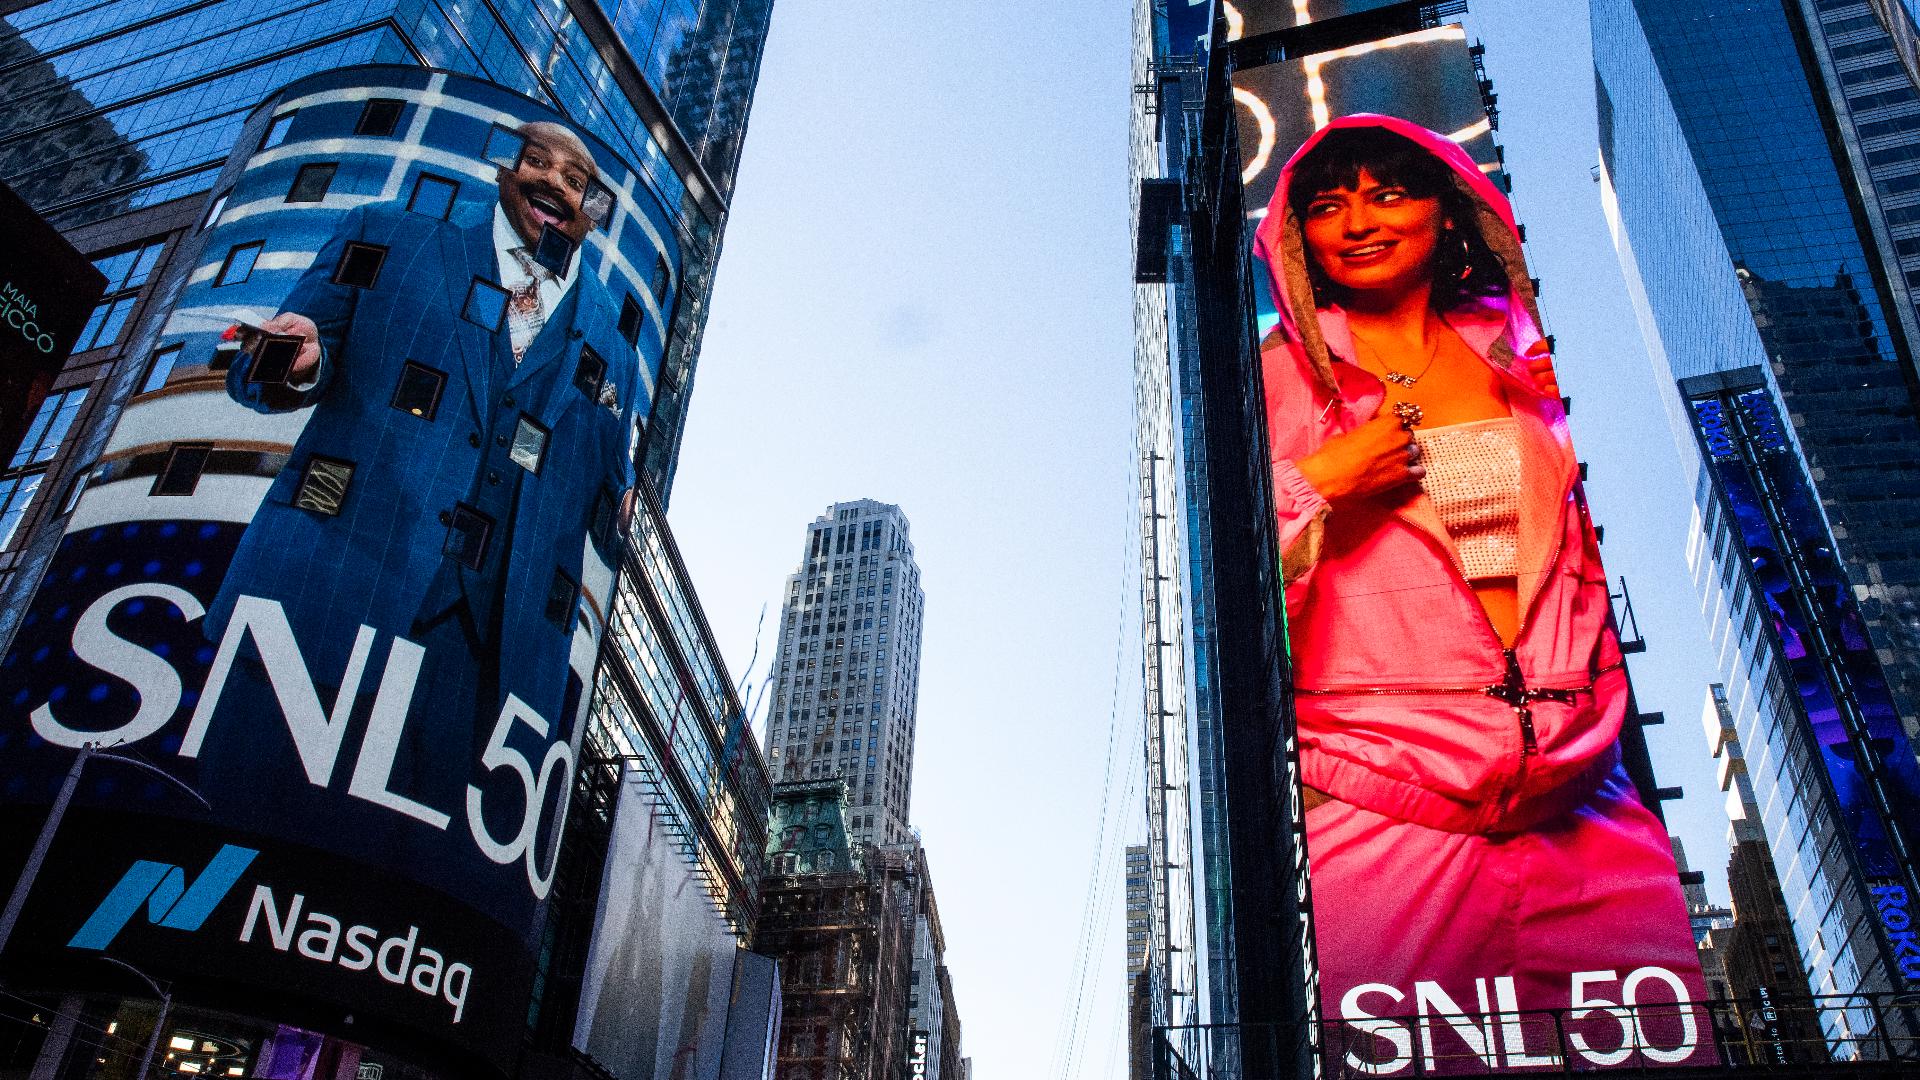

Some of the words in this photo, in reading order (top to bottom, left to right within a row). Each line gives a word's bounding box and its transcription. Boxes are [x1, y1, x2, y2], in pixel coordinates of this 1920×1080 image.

[3, 281, 37, 319] MAIA
[1695, 401, 1733, 457] ROKU
[29, 582, 452, 831] SNL
[466, 692, 574, 900] 50
[239, 884, 473, 1024] Nasdaq
[1871, 885, 1920, 979] ROKU
[1339, 975, 1564, 1075] SNL
[1569, 966, 1698, 1066] 50
